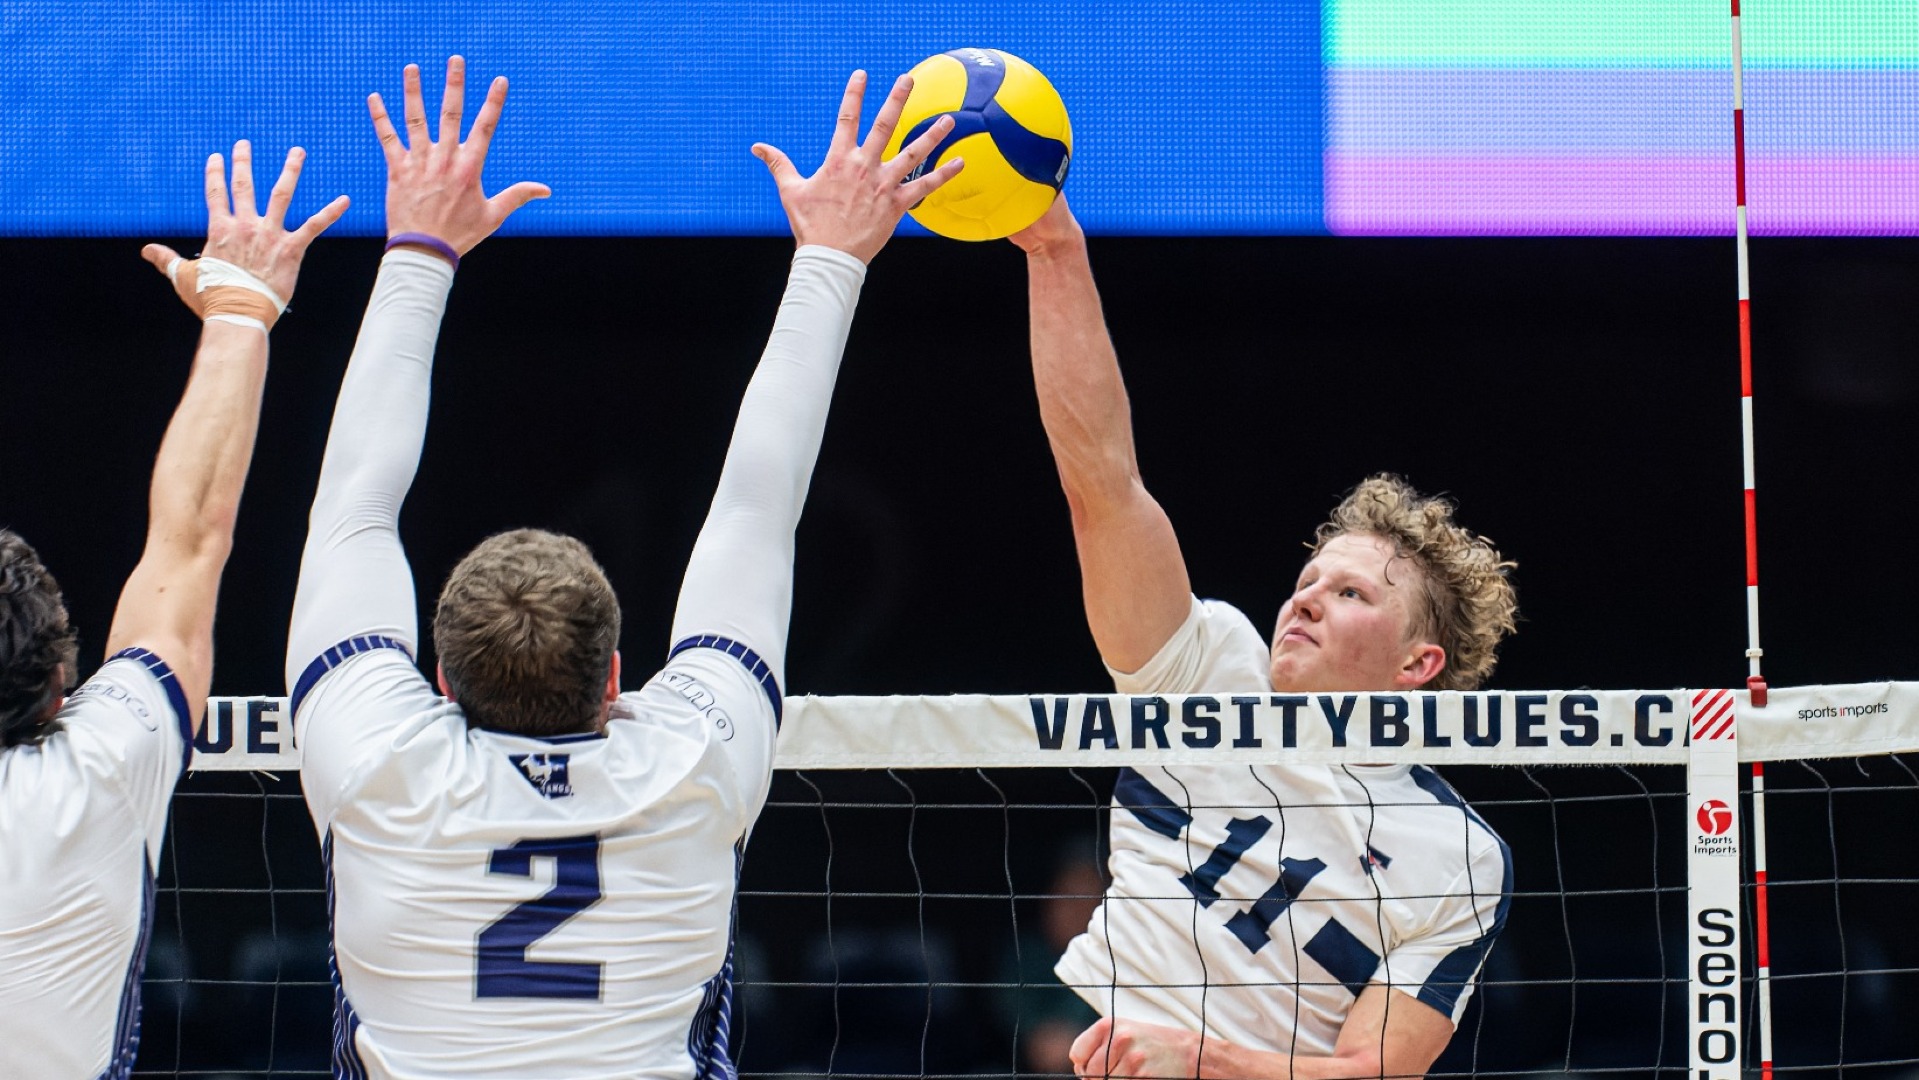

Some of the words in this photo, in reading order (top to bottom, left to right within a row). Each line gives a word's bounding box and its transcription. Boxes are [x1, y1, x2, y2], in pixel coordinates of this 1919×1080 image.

[194, 701, 298, 754] UE
[1029, 694, 1690, 750] VARSITYBLUES.C
[1798, 706, 1837, 721] sports
[1839, 702, 1889, 718] imports
[1694, 844, 1737, 856] Imports
[1697, 835, 1733, 846] Sports
[1178, 814, 1328, 955] 11
[472, 834, 606, 1002] 2
[1697, 908, 1737, 1080] Seno
